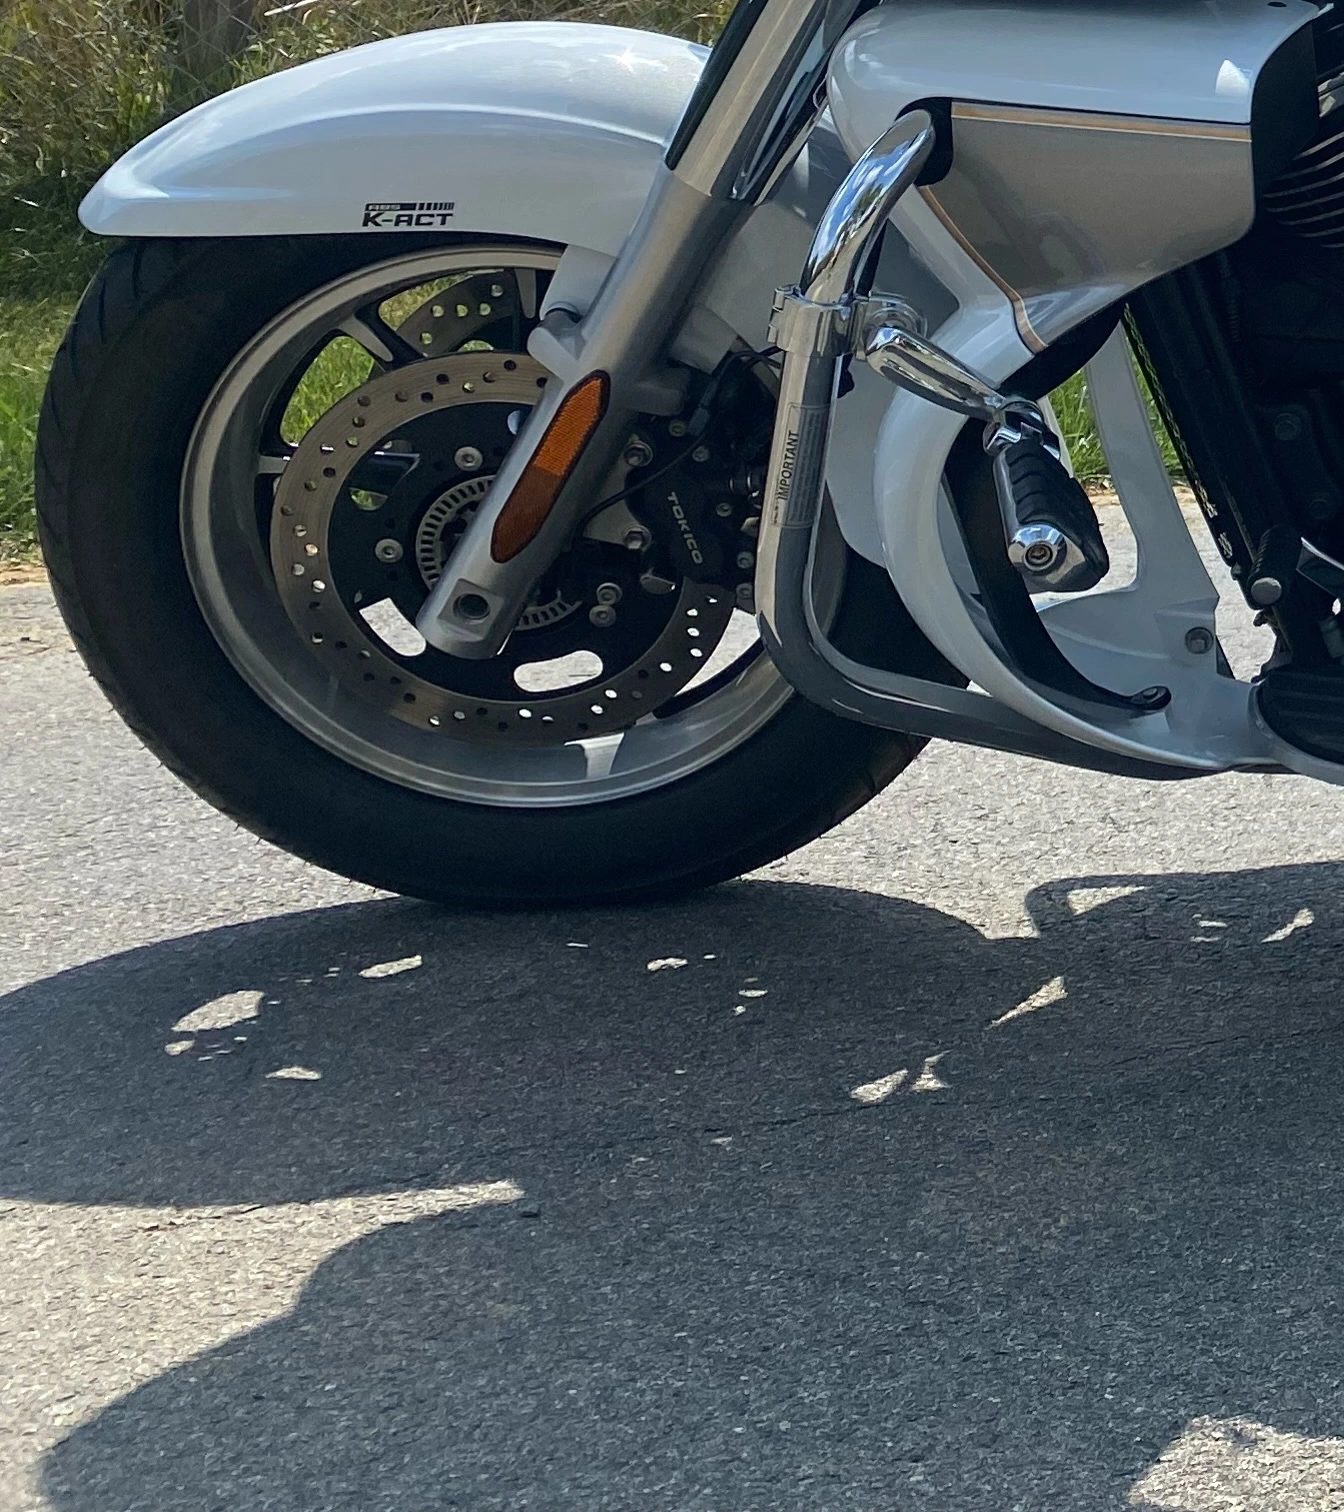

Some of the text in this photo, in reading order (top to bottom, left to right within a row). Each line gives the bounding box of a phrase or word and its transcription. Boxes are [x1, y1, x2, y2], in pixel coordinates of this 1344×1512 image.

[362, 212, 454, 227] K-ACT
[776, 430, 800, 501] IMPORTANT
[667, 491, 703, 564] TOKICO
